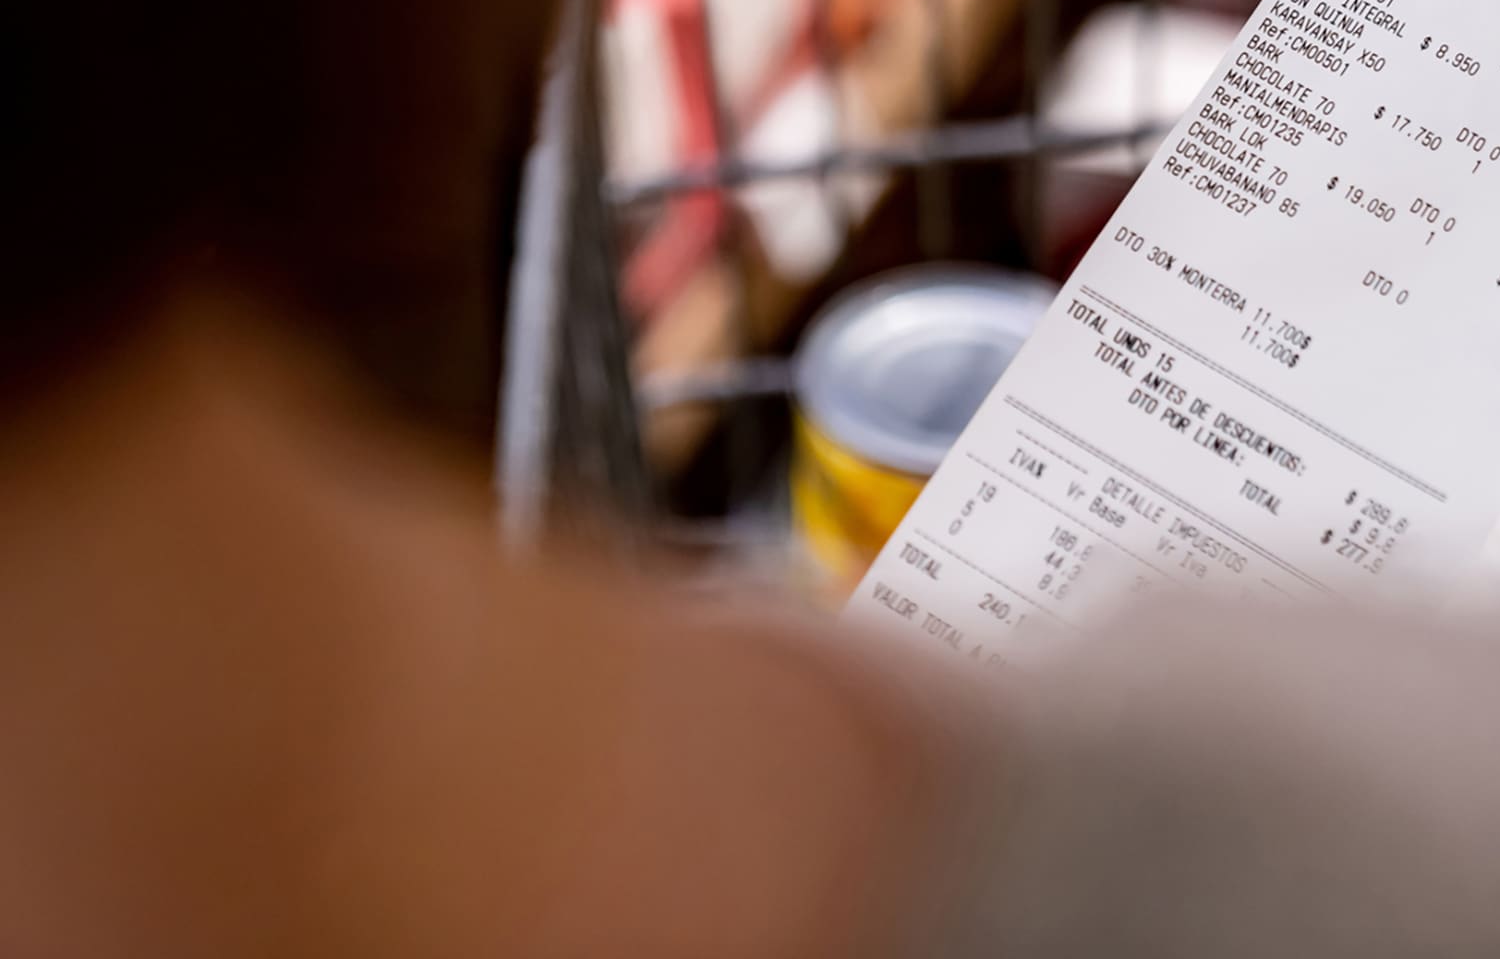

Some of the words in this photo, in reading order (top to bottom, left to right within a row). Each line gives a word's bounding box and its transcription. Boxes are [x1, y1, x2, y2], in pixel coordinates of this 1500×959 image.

[1269, 0, 1355, 54] KARAVANSAY
[1356, 48, 1385, 72] X50
[1313, 1, 1364, 38] QUINUA
[1235, 51, 1312, 103] CHOCOLATE
[1314, 95, 1335, 115] 70
[1246, 33, 1284, 63] BARK
[1391, 114, 1442, 151] 17.750
[1257, 16, 1349, 76] Ref:CM00501
[1455, 126, 1486, 152] DTO
[1435, 43, 1480, 76] 8.950
[1222, 68, 1347, 146] MANIALMENDRAPIS
[1175, 137, 1276, 204] UCHUVABANANO
[1278, 197, 1300, 217] 85
[1187, 120, 1265, 173] CHOCOLATE
[1267, 165, 1288, 186] 70
[1198, 102, 1237, 133] BARK
[1238, 126, 1268, 151] LOK
[1344, 184, 1395, 222] 19.050
[1210, 85, 1304, 146] Ref:CM01235
[1409, 197, 1440, 223] DTO
[1162, 155, 1257, 216] Ref:CM01237
[1361, 269, 1393, 296] DTO
[1113, 225, 1144, 252] DTO
[1146, 245, 1176, 271] 30%
[1178, 264, 1246, 312] MONTERRA
[1253, 307, 1312, 350] 11.700$
[1066, 298, 1108, 335] TOTAL
[1113, 327, 1151, 358] UNDS
[1155, 352, 1175, 372] 15
[1241, 325, 1300, 368] 11.700$
[1094, 341, 1135, 377] TOTAL
[1140, 371, 1186, 404] ANTES
[1188, 397, 1211, 420] DE
[1212, 411, 1305, 475] DESCUENTOS:
[1127, 387, 1159, 414] DTO
[1160, 407, 1191, 432] POR
[1193, 426, 1243, 465] LINEA:
[976, 480, 997, 503] 19
[1009, 447, 1046, 478] IVA%
[1066, 480, 1086, 500] Vr
[1088, 495, 1126, 528] Base
[1100, 476, 1165, 524] DETALLE
[1167, 516, 1247, 573] IMPUESTOS
[1239, 478, 1280, 515] TOTAL
[899, 541, 941, 580] TOTAL
[872, 581, 918, 620] VALOR
[920, 611, 963, 650] TOTAL
